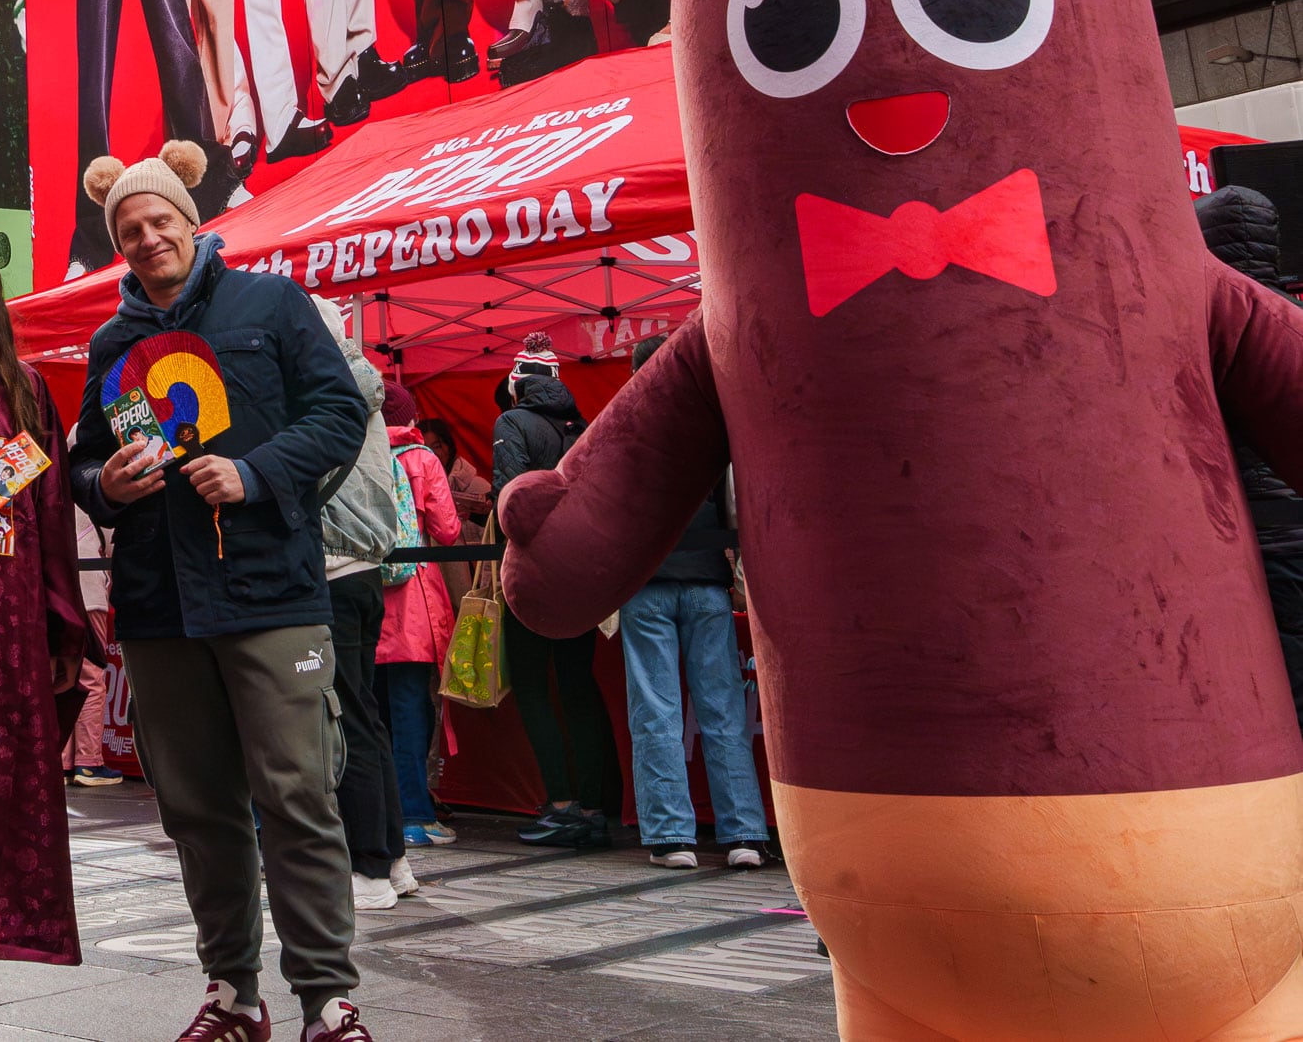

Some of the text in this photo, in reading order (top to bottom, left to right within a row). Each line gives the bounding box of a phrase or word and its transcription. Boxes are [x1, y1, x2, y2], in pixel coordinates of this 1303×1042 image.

[487, 124, 523, 144] in
[519, 96, 632, 134] Korea
[304, 208, 495, 289] PEPERO
[502, 177, 626, 250] DAY
[110, 399, 150, 436] PEPERO
[295, 658, 321, 673] PUMA
